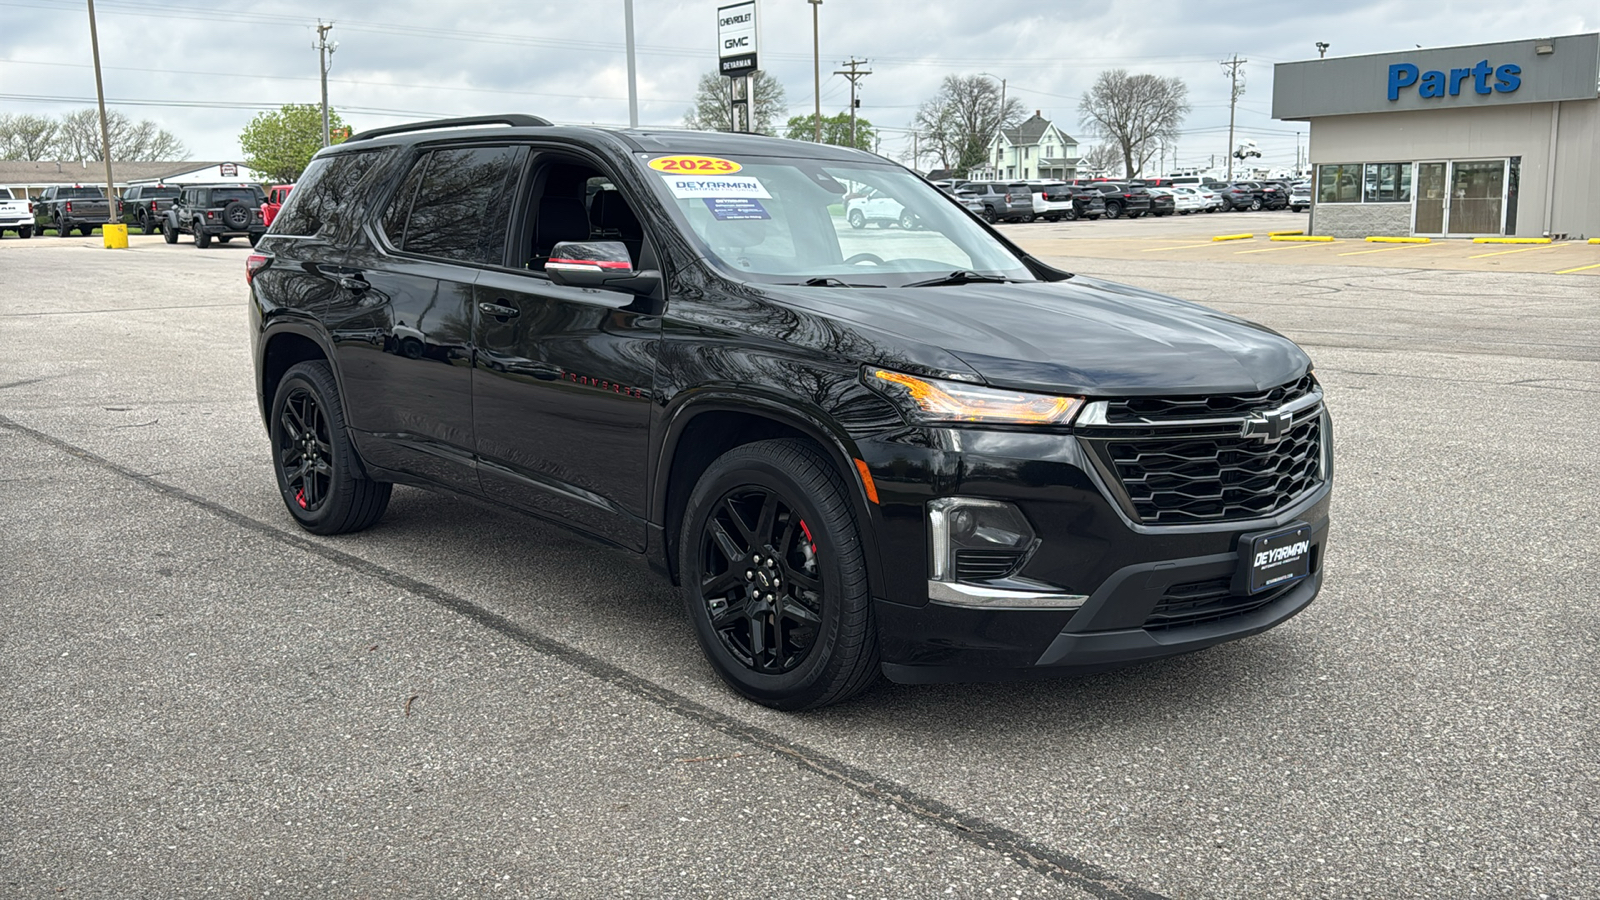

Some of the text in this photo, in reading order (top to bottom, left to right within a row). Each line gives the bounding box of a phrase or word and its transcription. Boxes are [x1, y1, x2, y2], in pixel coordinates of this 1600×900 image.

[720, 13, 751, 26] CHEVROLET
[725, 36, 748, 49] GMC
[723, 59, 751, 70] DEYARMAN
[1387, 59, 1522, 101] Parts
[661, 160, 733, 170] 2023
[676, 181, 757, 189] DEYARMAN
[560, 369, 642, 398] TRAVERSE
[1254, 540, 1309, 567] DEYARMAN
